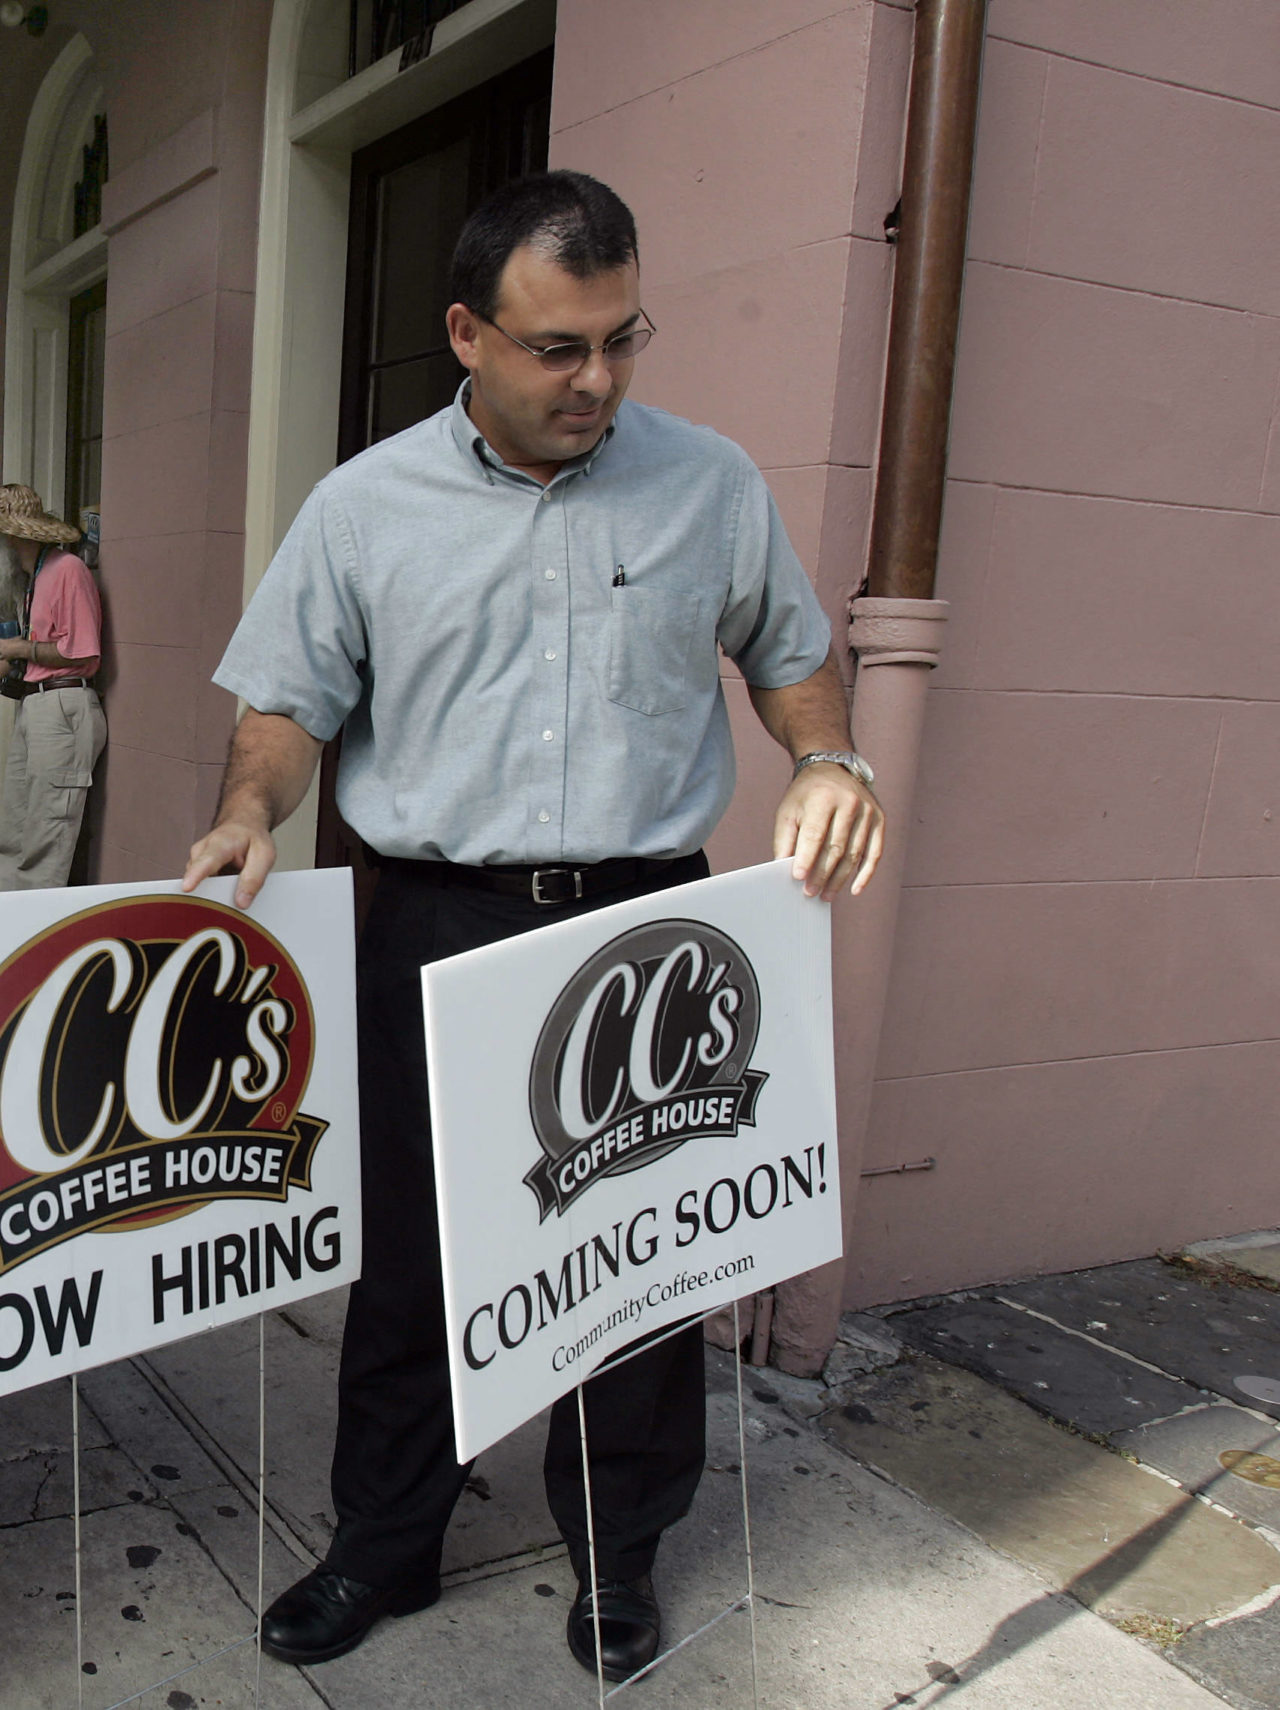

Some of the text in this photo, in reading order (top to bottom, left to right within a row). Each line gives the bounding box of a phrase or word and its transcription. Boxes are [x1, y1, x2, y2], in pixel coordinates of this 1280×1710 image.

[0, 927, 288, 1173] CC's
[558, 940, 740, 1140] CC's
[164, 1145, 284, 1188] HOUSE
[557, 1096, 735, 1194] COFFEE HOUSE
[150, 1205, 343, 1325] HIRING
[461, 1141, 827, 1372] COMING SOON!
[551, 1253, 756, 1373] CommunityCoffee.com
